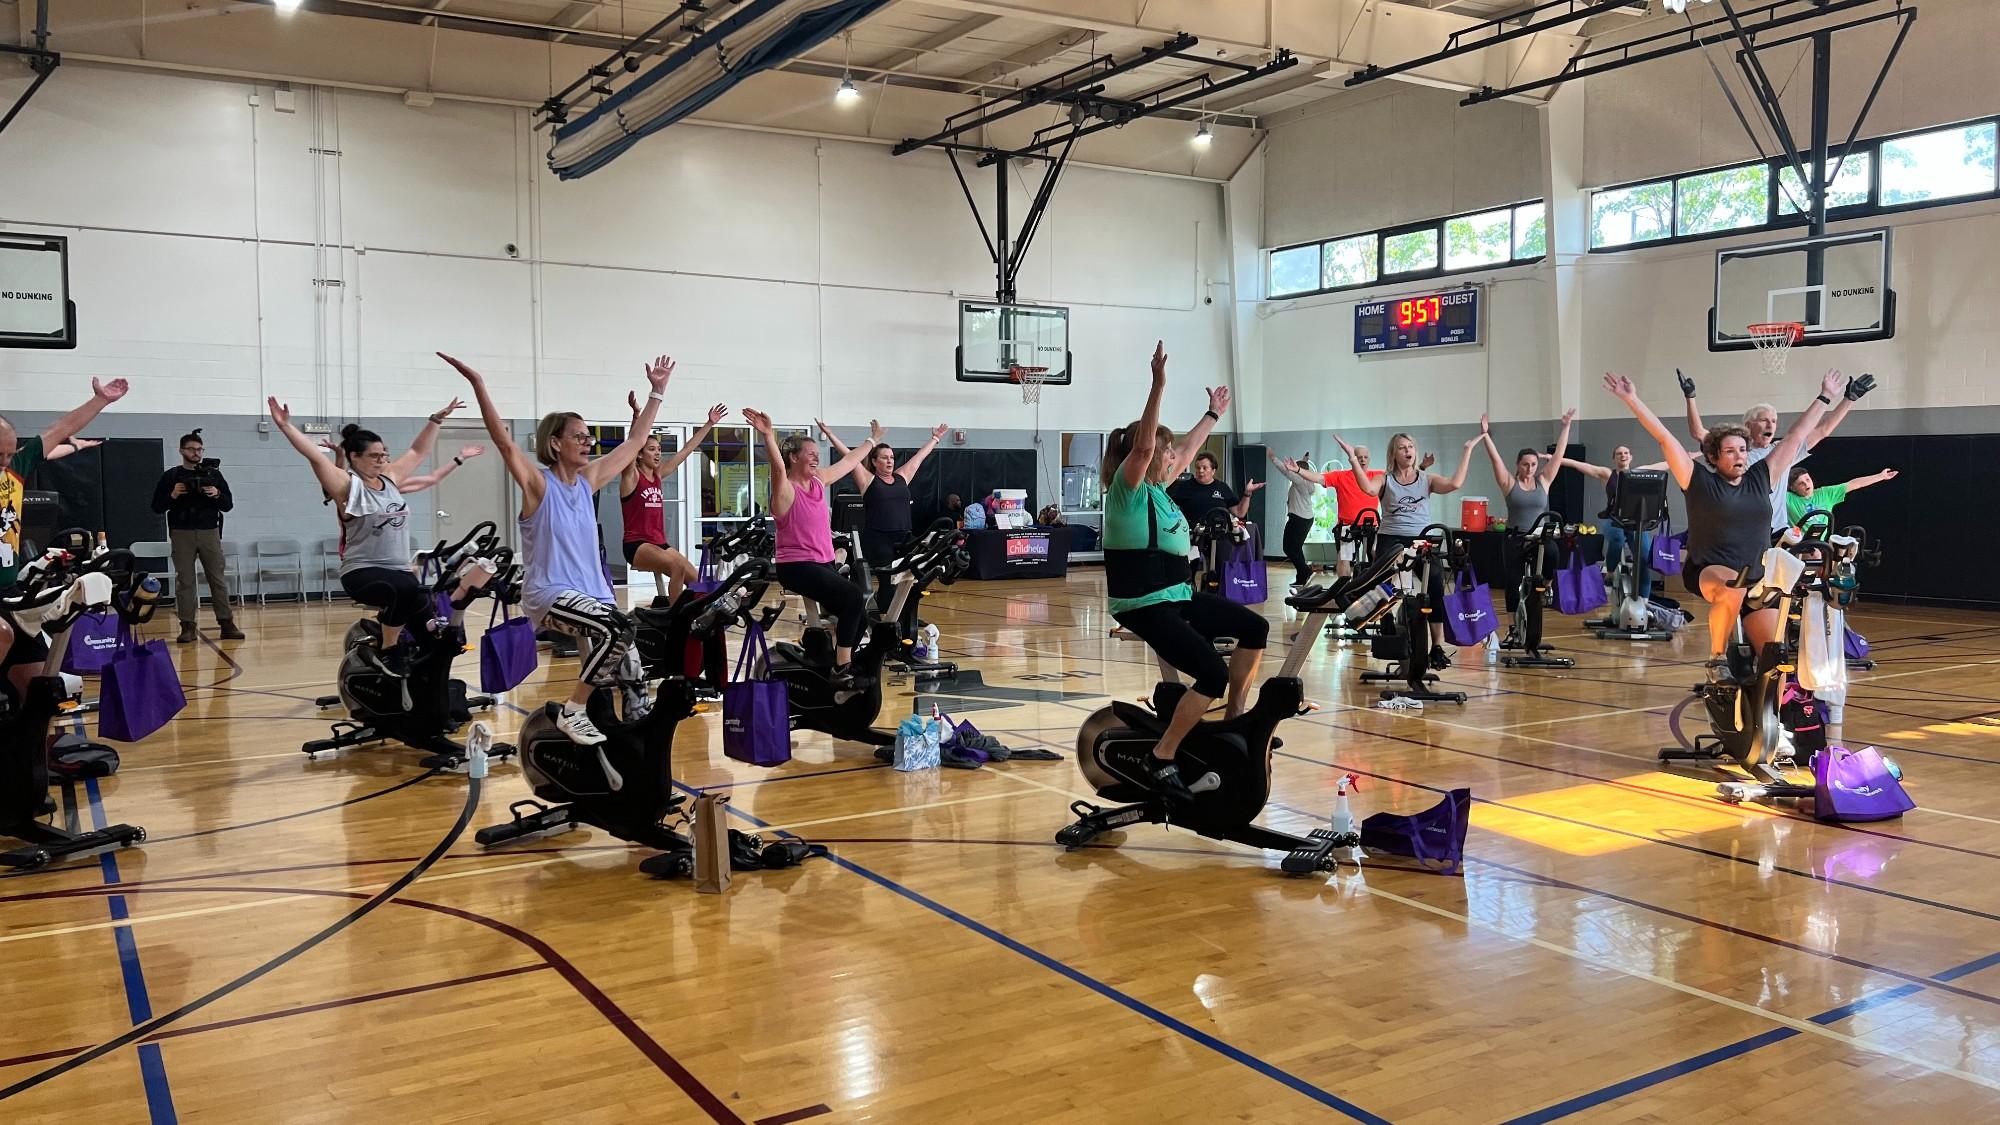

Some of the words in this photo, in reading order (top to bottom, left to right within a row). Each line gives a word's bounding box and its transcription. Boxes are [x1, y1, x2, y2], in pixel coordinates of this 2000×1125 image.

[2, 291, 14, 299] NO
[16, 292, 53, 301] DUNKING
[1832, 290, 1841, 298] NO
[1843, 286, 1874, 296] DUNKING
[1442, 293, 1474, 306] GUEST
[1358, 305, 1385, 316] HOME
[1401, 298, 1439, 325] 9:57
[1117, 752, 1142, 764] MAT
